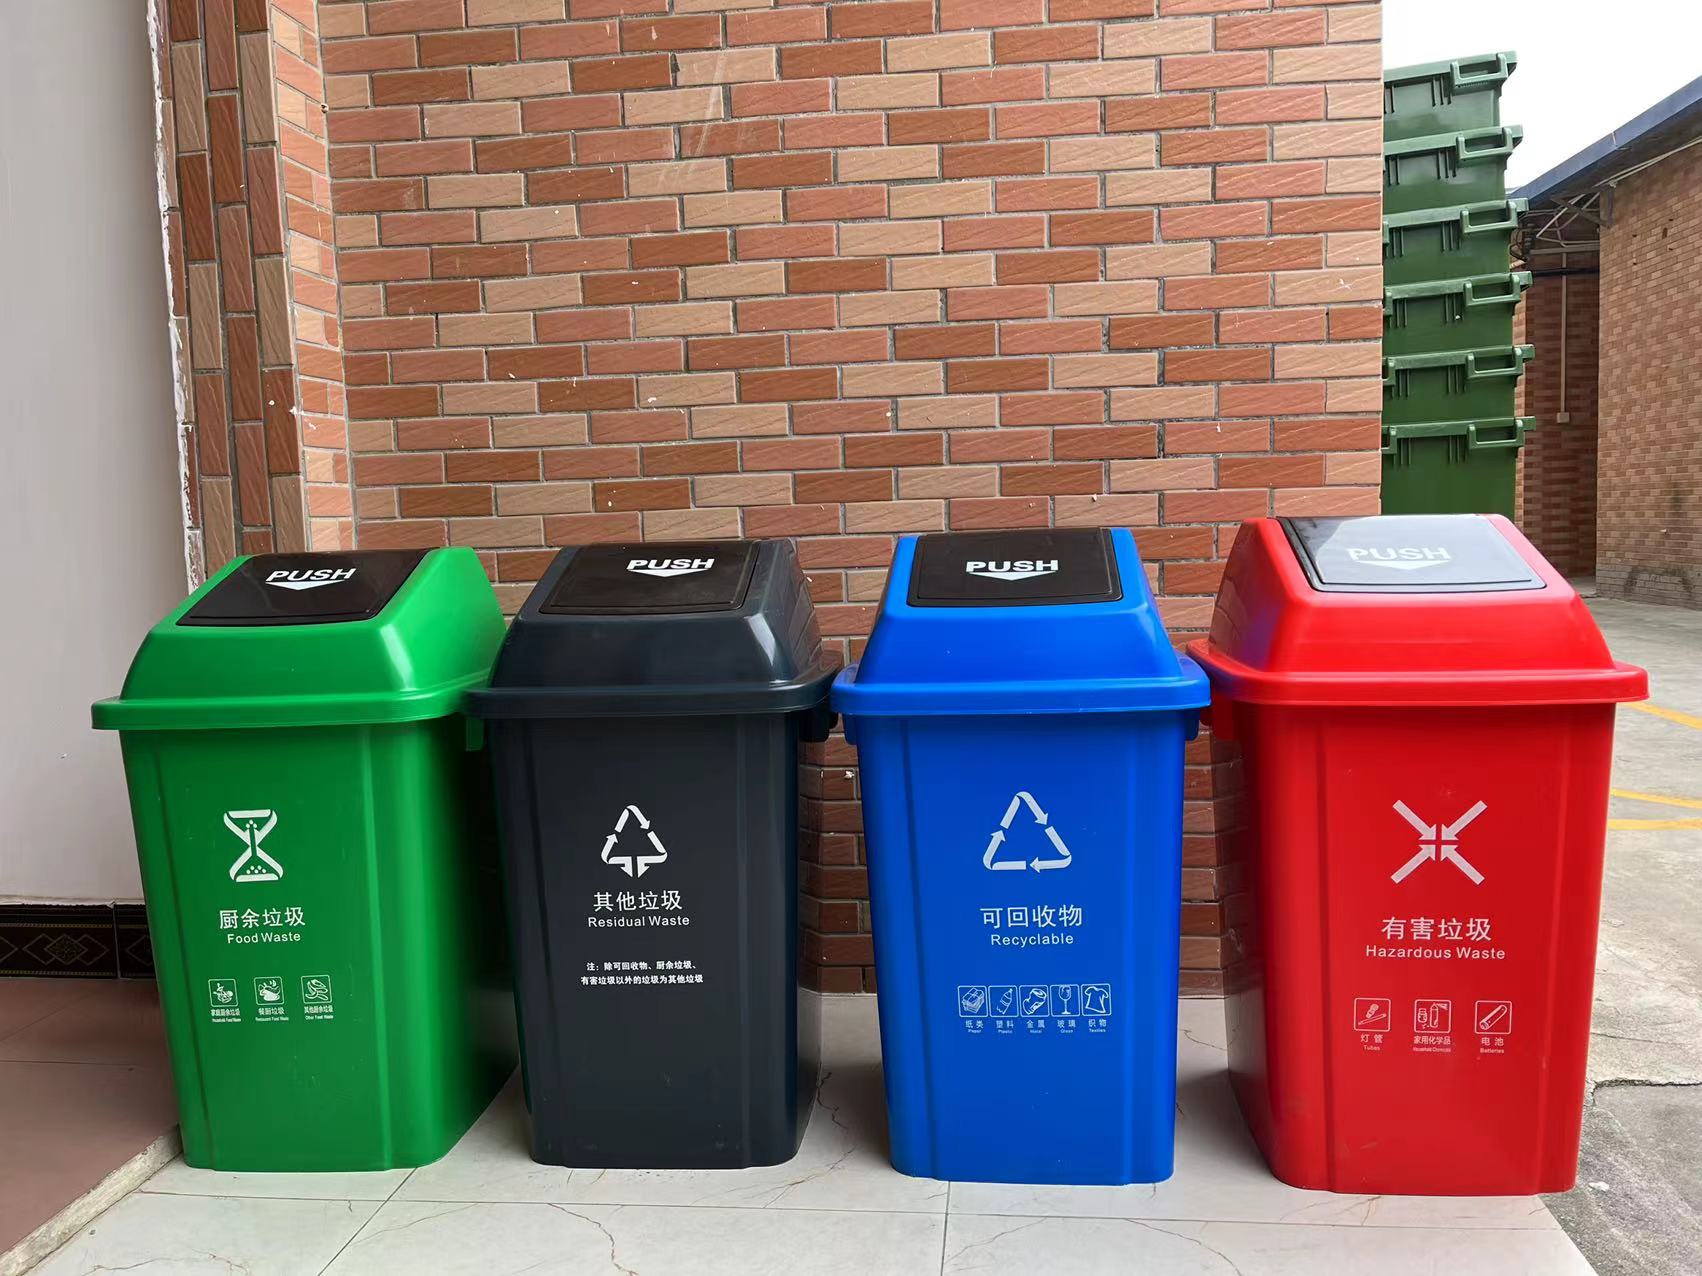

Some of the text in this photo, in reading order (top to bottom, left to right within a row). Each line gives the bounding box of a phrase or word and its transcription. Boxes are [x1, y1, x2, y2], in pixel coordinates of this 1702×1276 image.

[1347, 547, 1450, 561] PUSH
[626, 557, 715, 572] PUSH
[965, 559, 1059, 574] PUSH
[265, 567, 357, 582] PUSH
[593, 889, 683, 912] 其他垃圾
[219, 906, 306, 929] 厨余垃圾
[588, 915, 690, 928] Residual Waste
[979, 904, 1083, 929] 可回收物
[1381, 916, 1492, 942] 有害垃圾
[227, 931, 301, 944] Food Waste
[990, 932, 1074, 948] Recyclable
[1365, 945, 1506, 960] Hazardous Waste
[580, 974, 704, 986] 有害垃圾以外的垃圾为其他垃圾
[965, 1019, 984, 1029] 纸类
[1088, 1018, 1107, 1028] 织物
[1360, 1034, 1384, 1044] 灯管
[1413, 1036, 1451, 1045] 家用化学品
[1480, 1037, 1505, 1046] 电池
